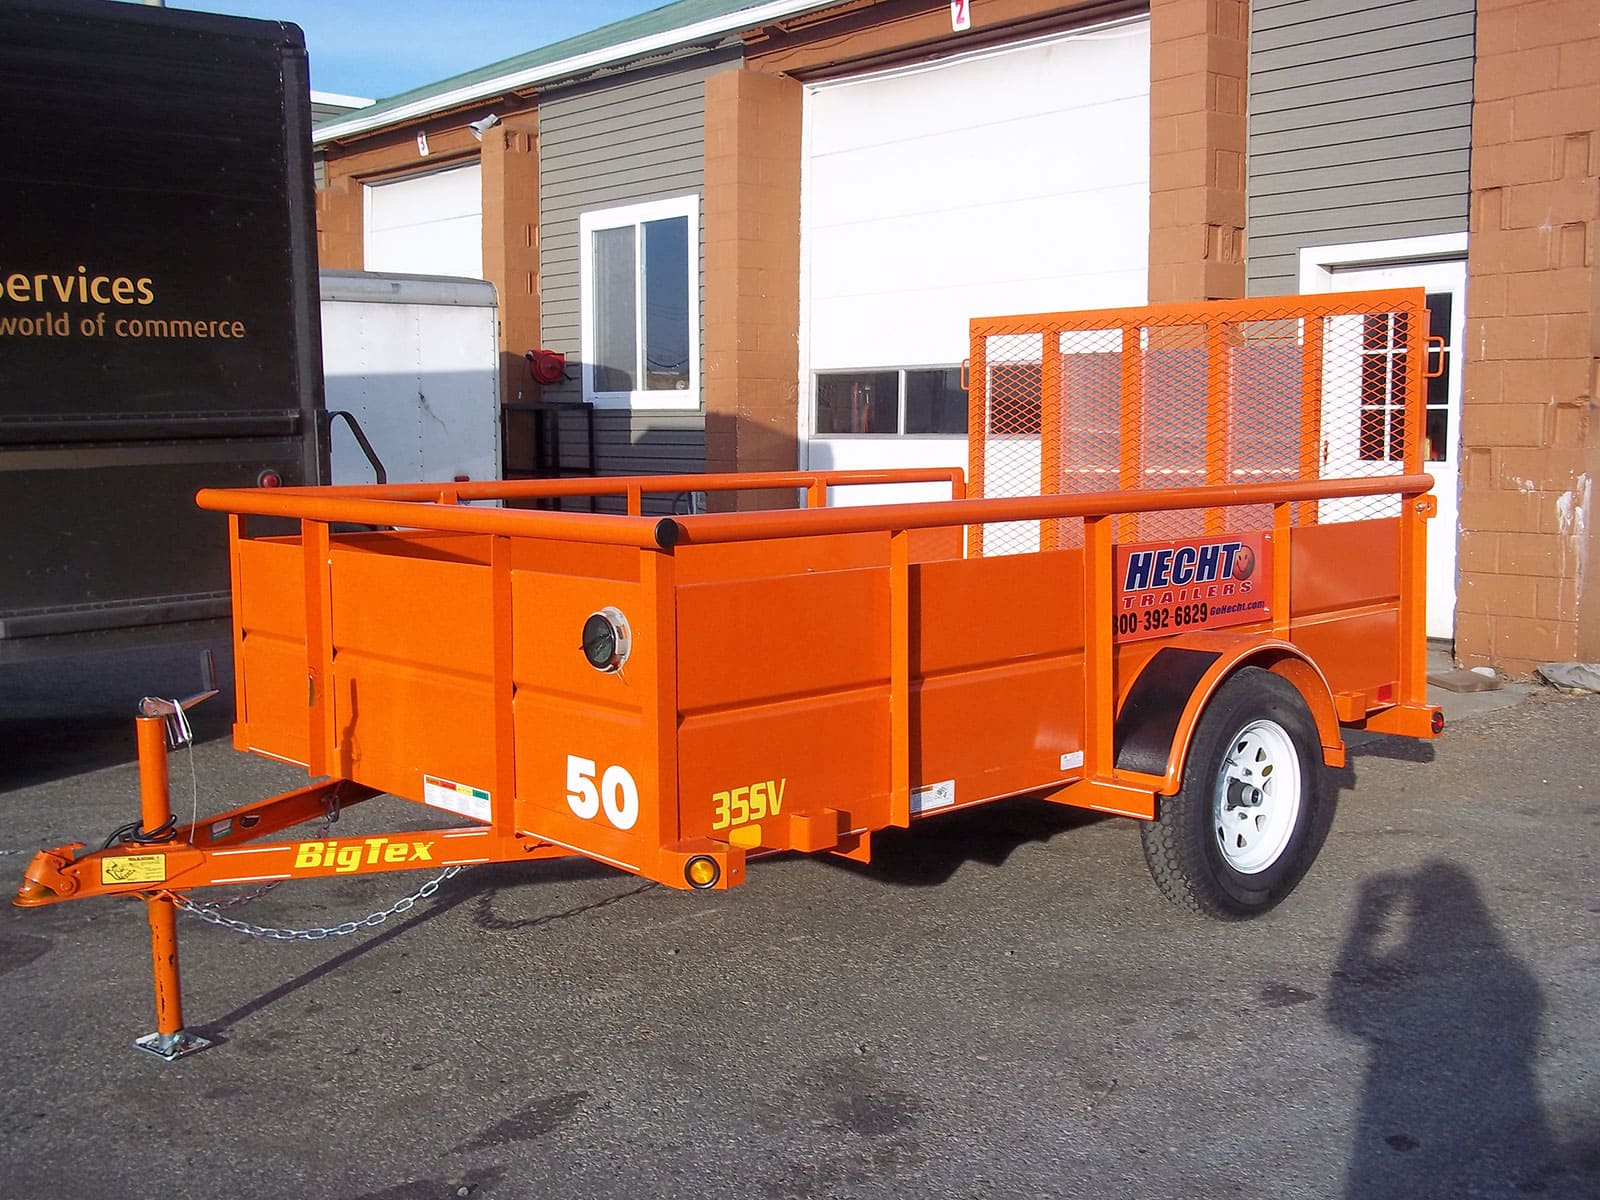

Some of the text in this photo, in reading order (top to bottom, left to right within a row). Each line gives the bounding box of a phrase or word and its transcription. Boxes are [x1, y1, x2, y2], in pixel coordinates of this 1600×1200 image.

[955, 0, 965, 25] 2
[417, 129, 426, 151] 3
[0, 265, 155, 305] ervices
[80, 312, 105, 337] of
[115, 318, 246, 339] commerce
[1123, 541, 1242, 592] HECHT
[1122, 581, 1253, 610] TRAILERS
[1209, 601, 1265, 616] GoHecht.com
[566, 754, 639, 831] 50
[712, 777, 787, 831] 35SV
[294, 838, 435, 873] BigTex
